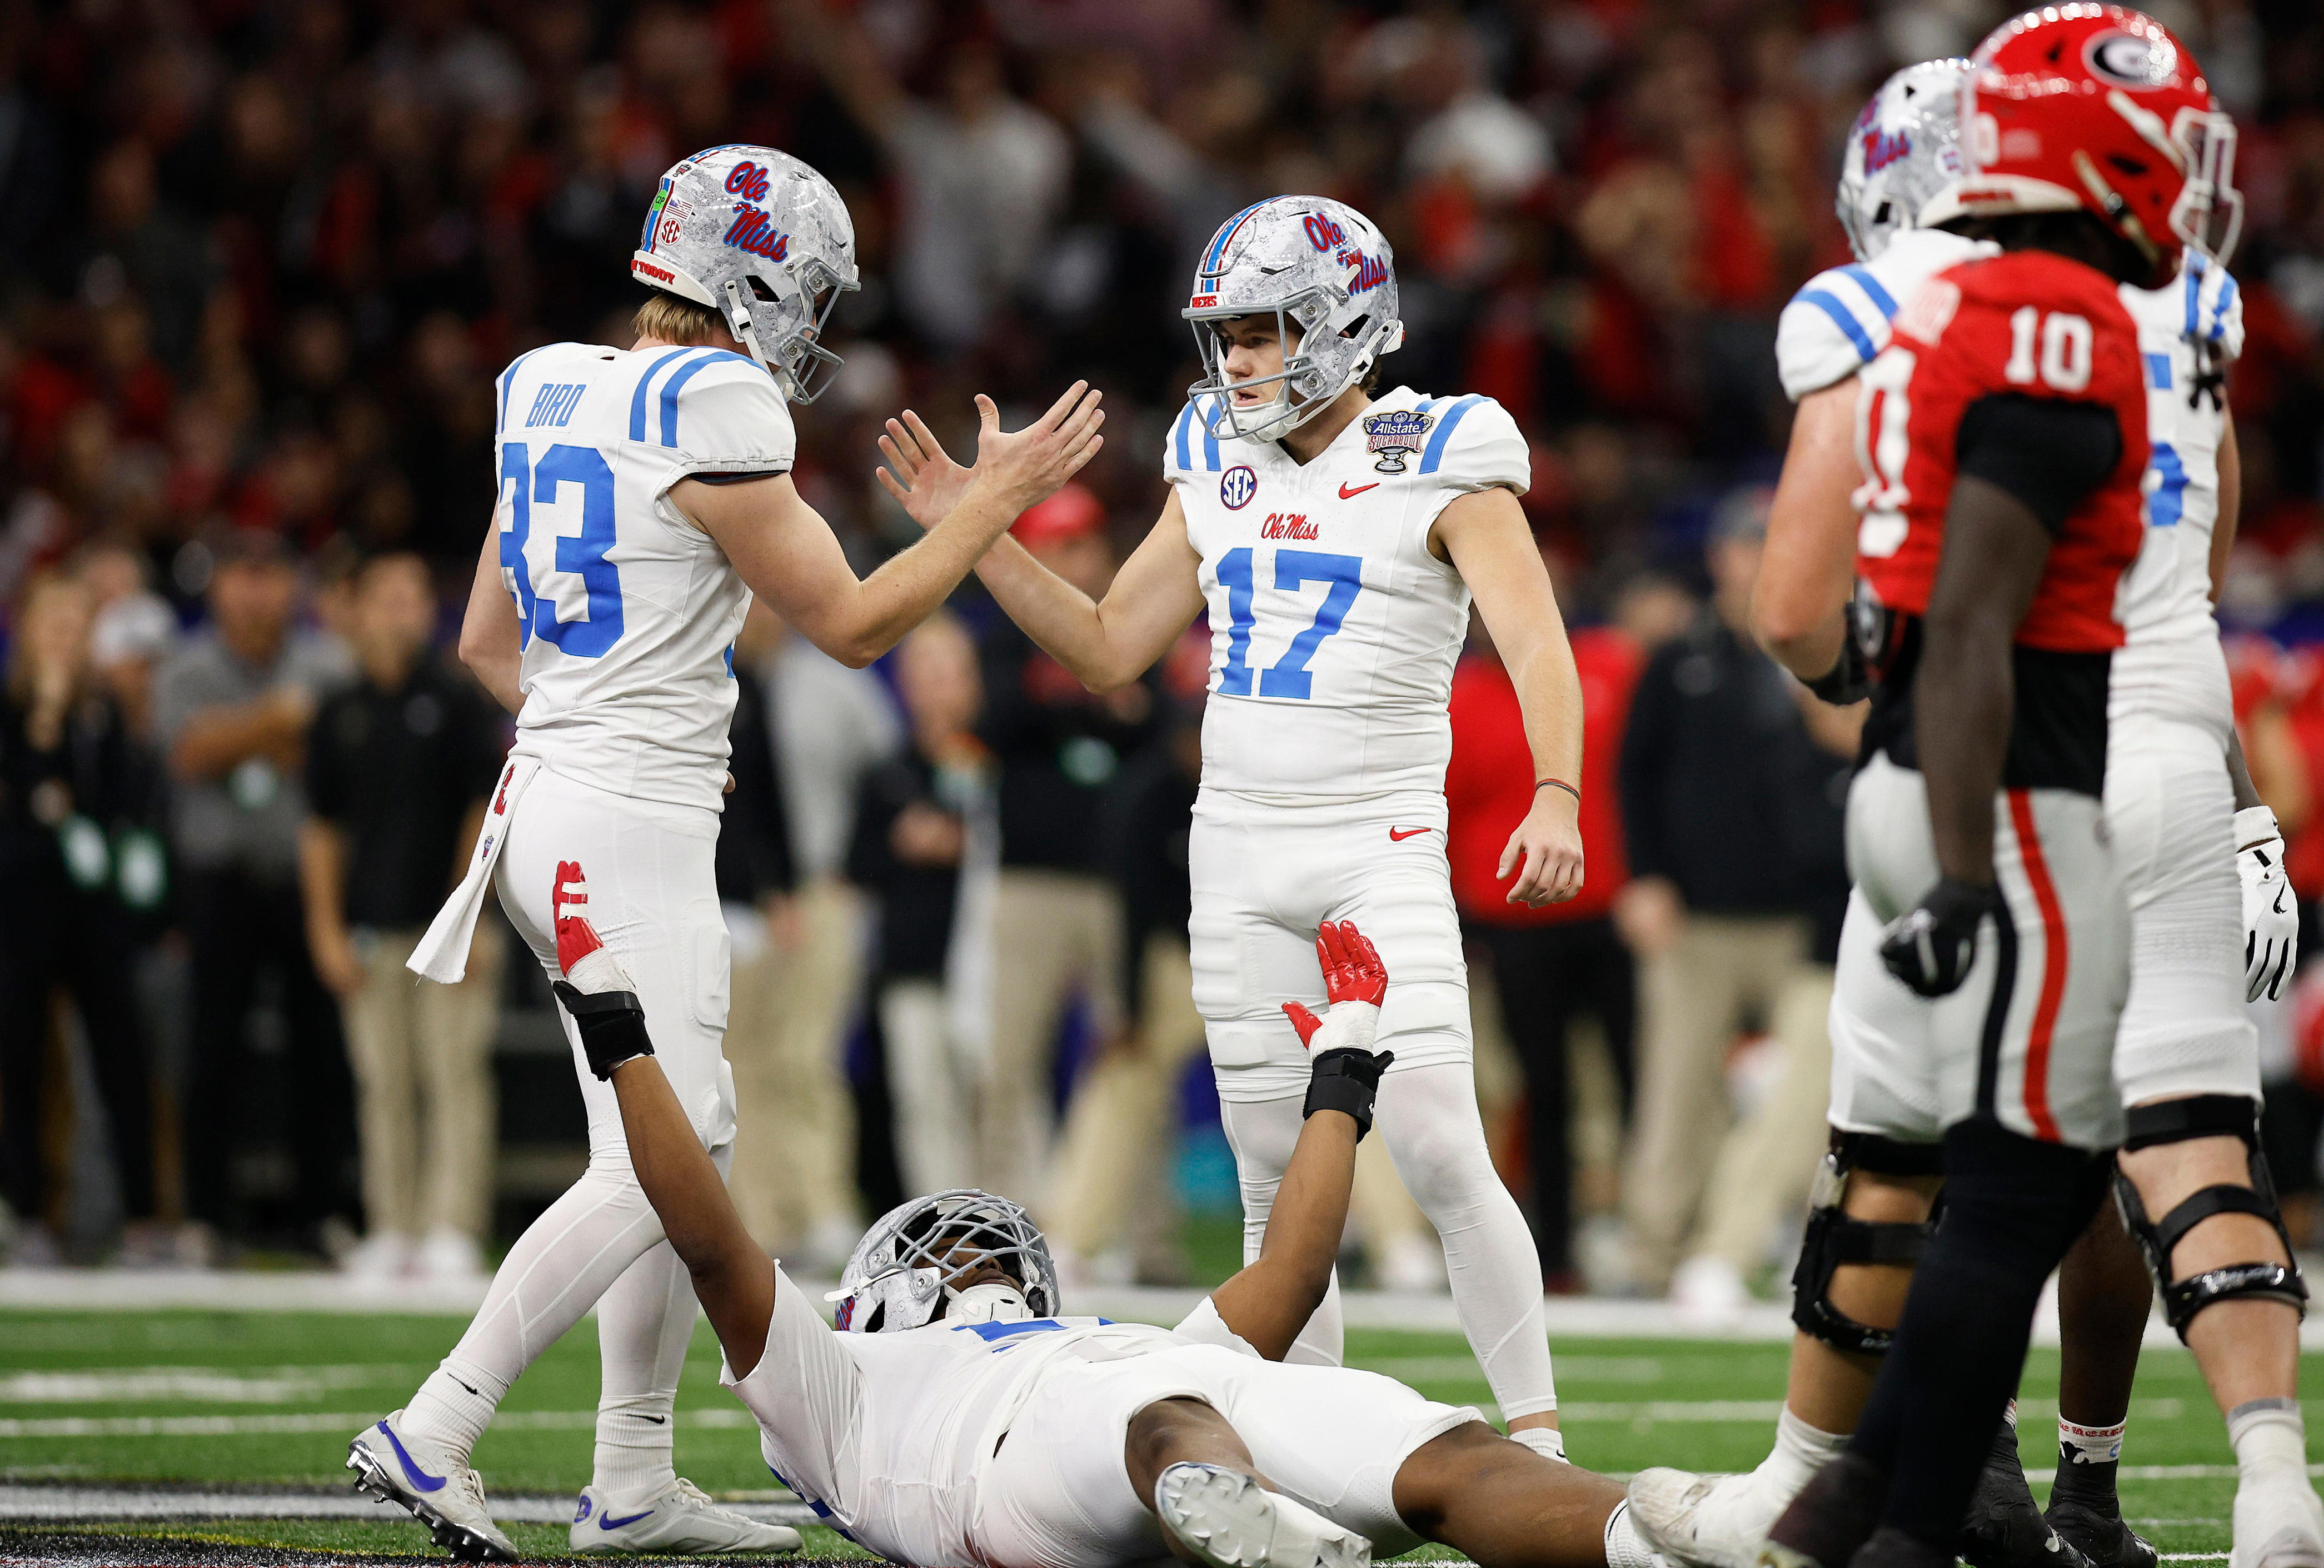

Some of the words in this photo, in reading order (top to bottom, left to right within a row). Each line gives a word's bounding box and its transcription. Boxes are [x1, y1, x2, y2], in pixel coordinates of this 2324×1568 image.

[725, 161, 770, 202] Ole
[661, 220, 680, 243] SEC
[723, 202, 790, 263] Miss
[1303, 212, 1348, 253] Ole
[639, 261, 675, 284] TODDY
[1336, 247, 1388, 297] Miss
[2004, 305, 2094, 394] 10
[525, 383, 587, 427] BIRD
[1373, 422, 1422, 434] Allstate
[1223, 468, 1254, 507] SEC
[1261, 512, 1285, 540] Ole
[1283, 513, 1319, 540] Miss
[1216, 547, 1363, 700] 17
